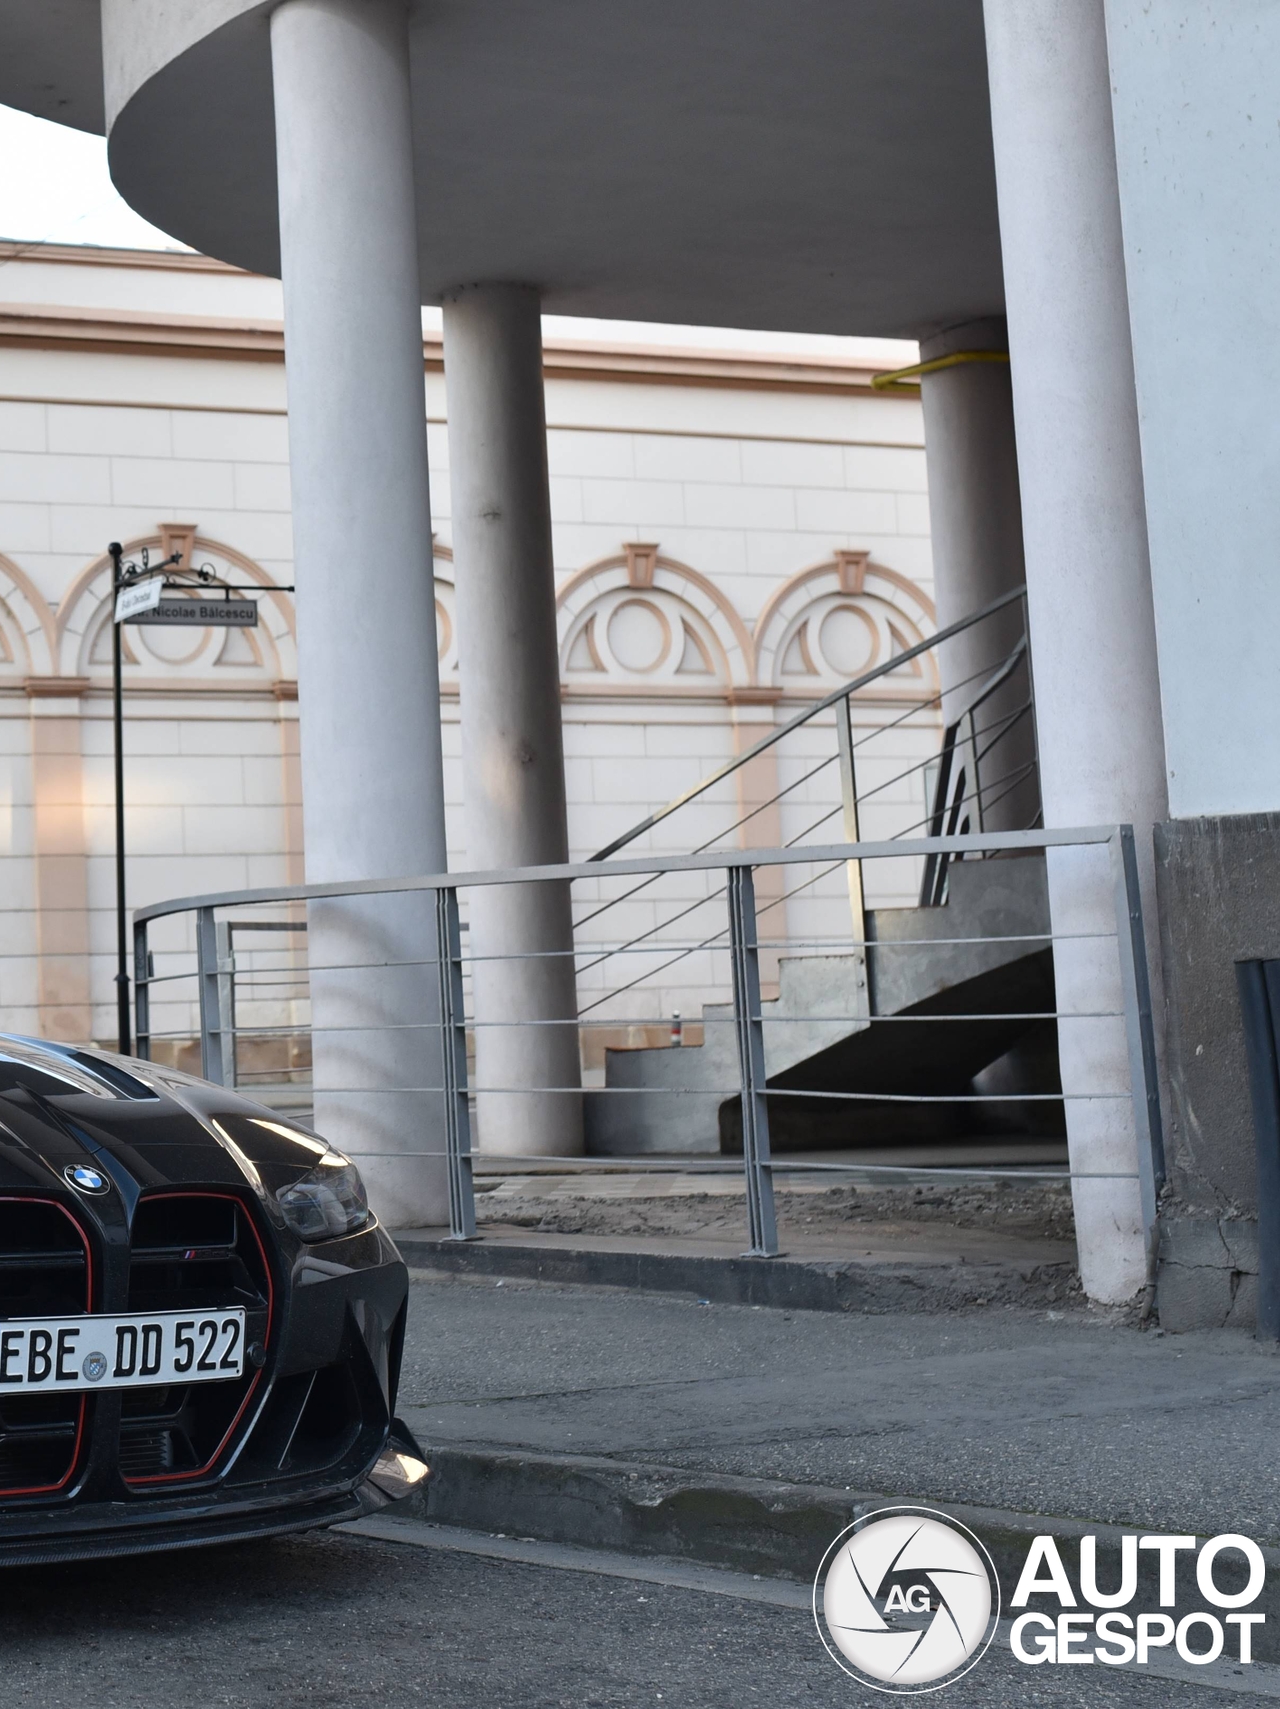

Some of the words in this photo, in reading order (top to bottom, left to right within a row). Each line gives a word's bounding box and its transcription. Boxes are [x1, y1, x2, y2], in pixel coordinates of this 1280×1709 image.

[152, 606, 196, 618] Nicolae
[112, 1323, 163, 1378] DD
[173, 1318, 241, 1373] 522
